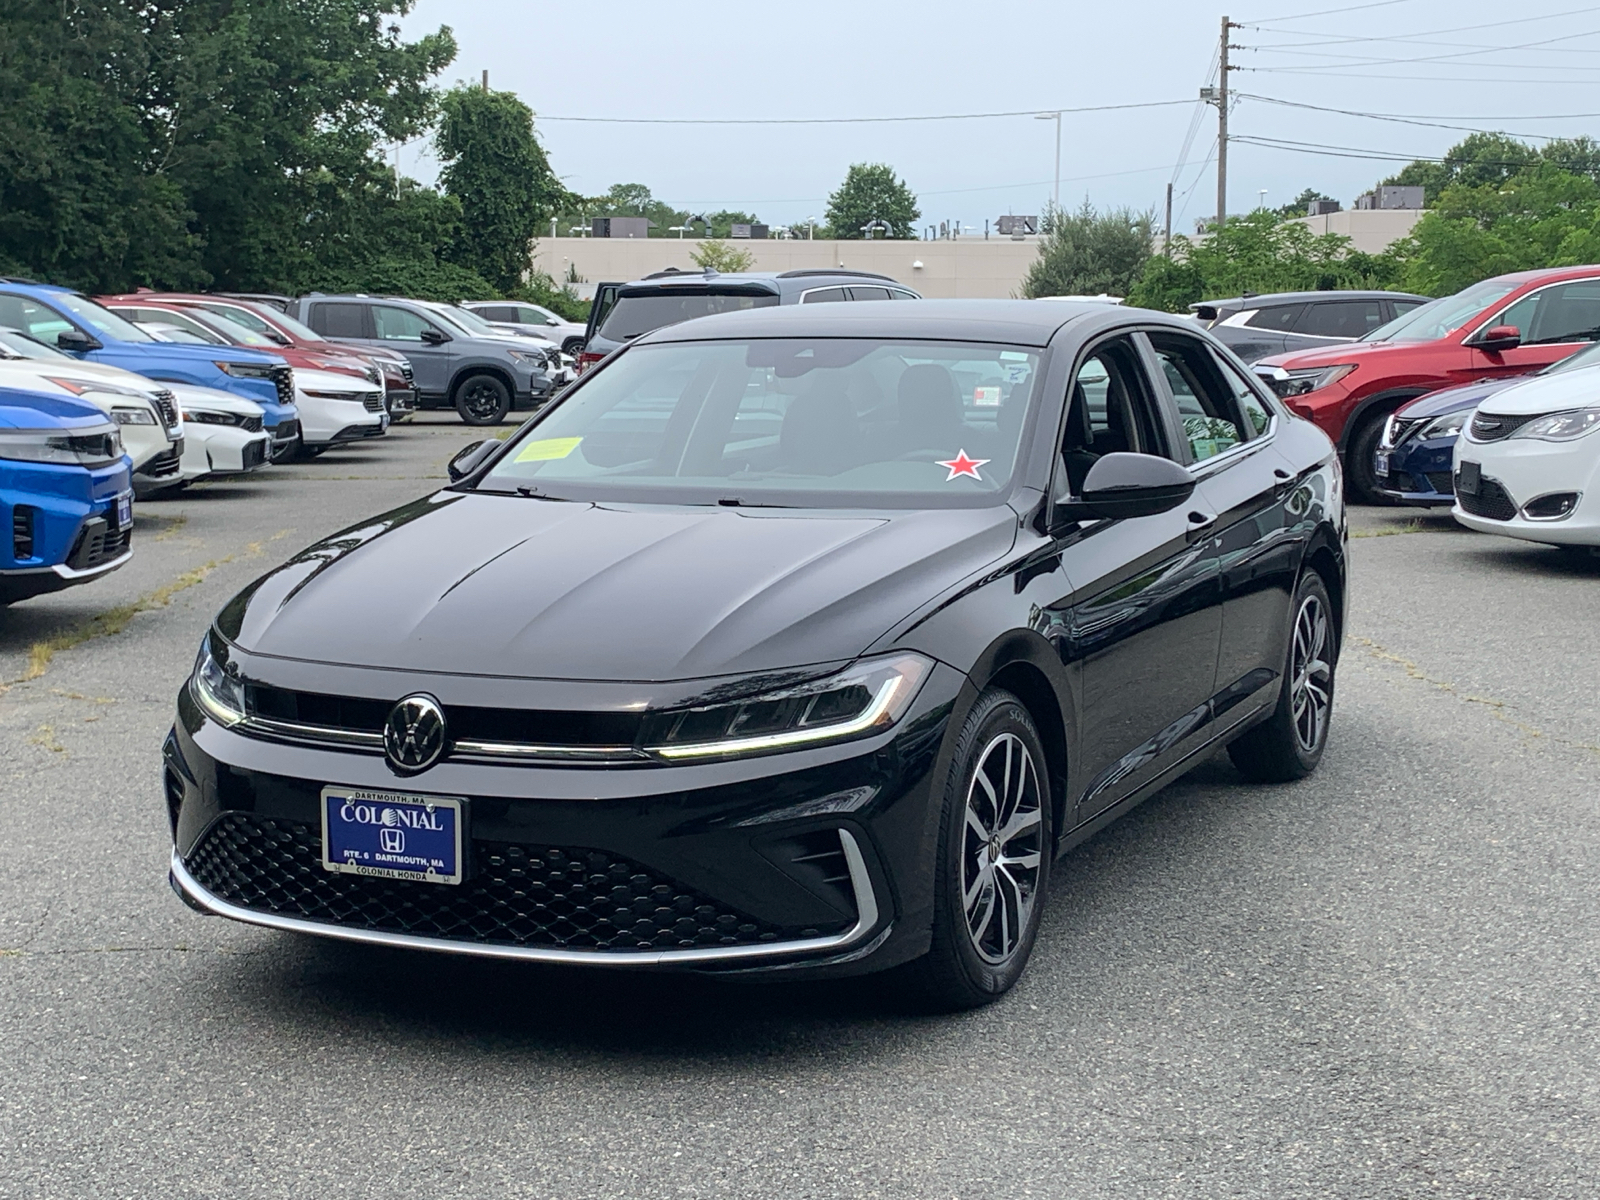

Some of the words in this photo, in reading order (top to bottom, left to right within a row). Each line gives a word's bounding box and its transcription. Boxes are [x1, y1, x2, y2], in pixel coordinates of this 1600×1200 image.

[341, 805, 443, 831] COLONIAL
[344, 850, 362, 859] RTE.
[375, 853, 429, 866] DARTMOUTH,
[431, 859, 444, 868] MA
[356, 867, 395, 878] COLONIAL
[398, 869, 427, 881] HONDA
